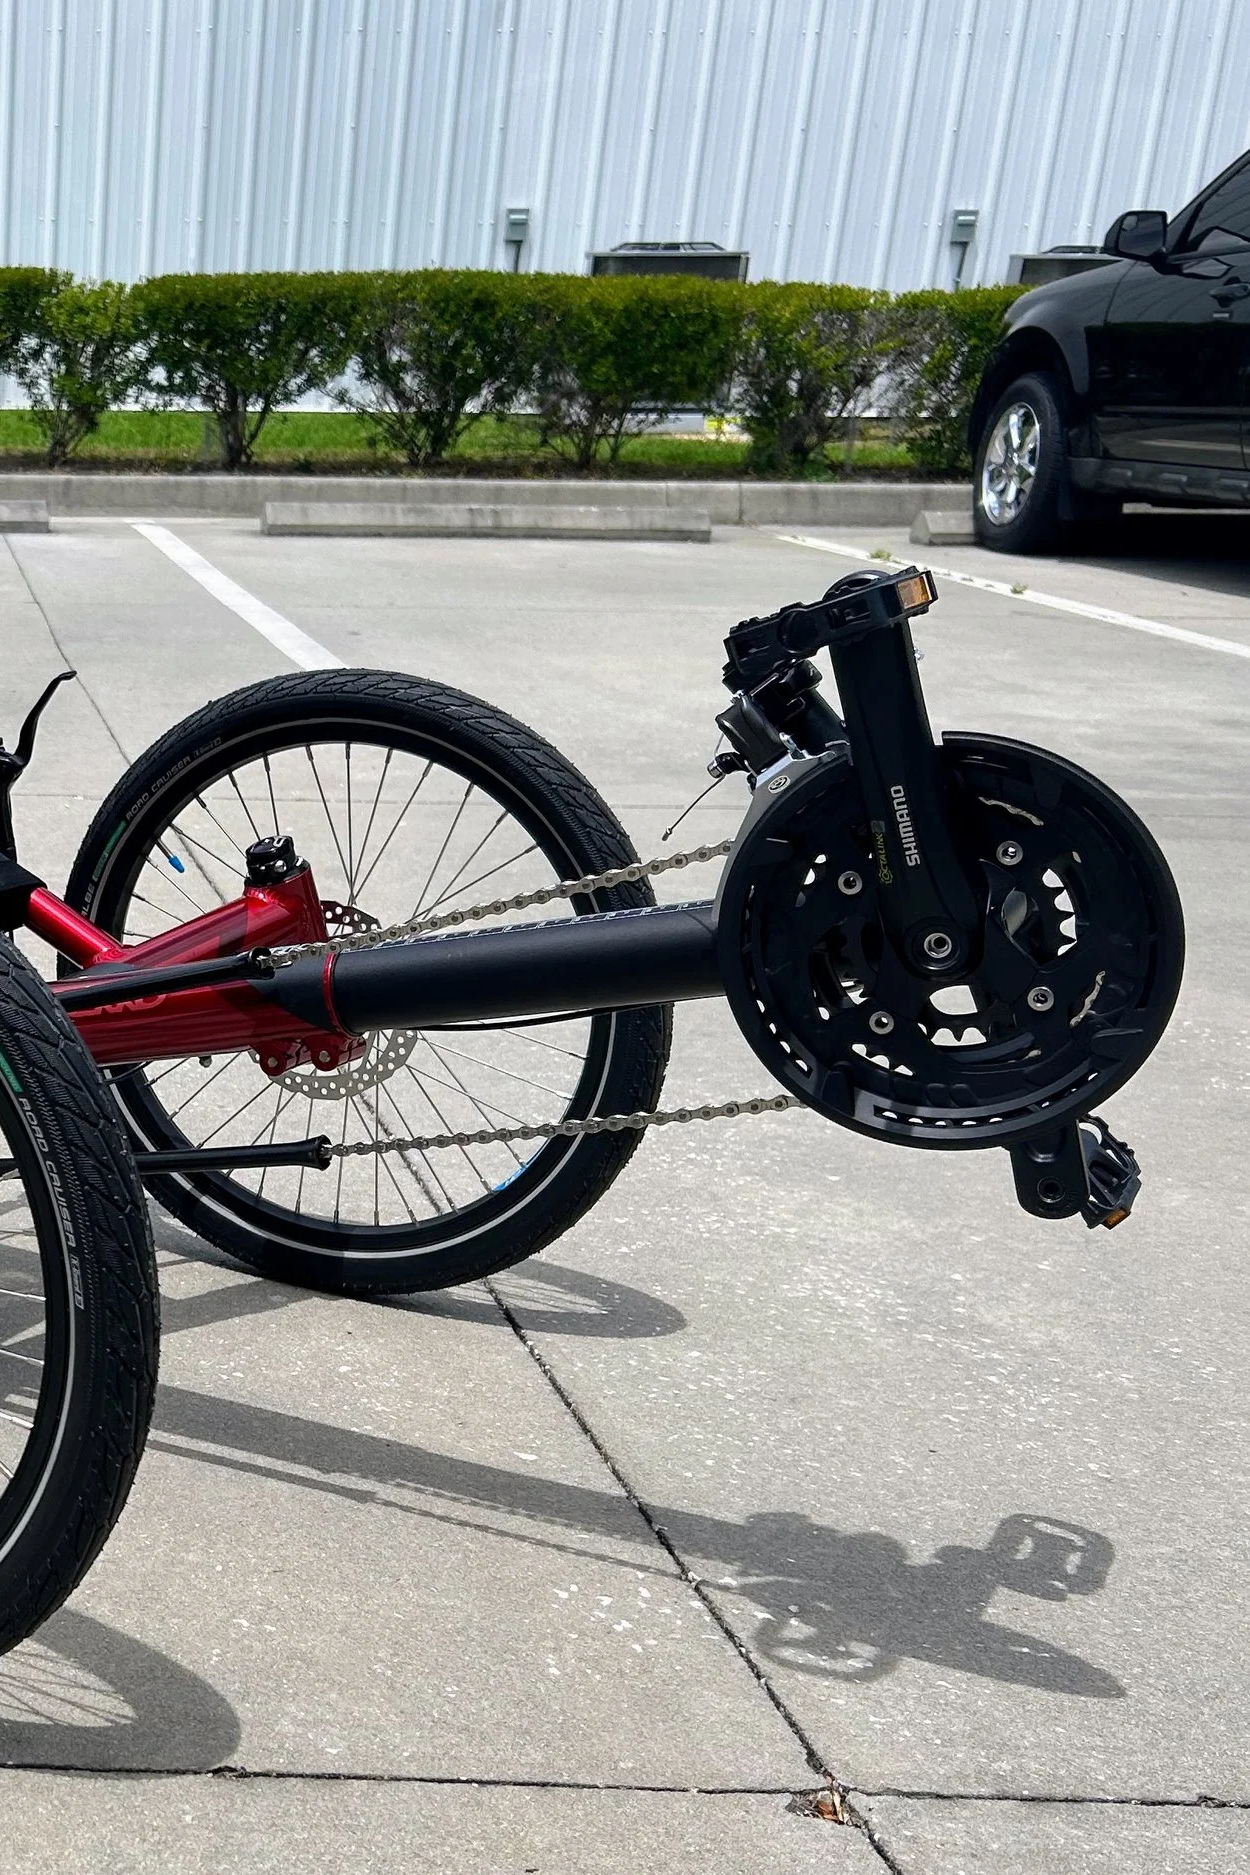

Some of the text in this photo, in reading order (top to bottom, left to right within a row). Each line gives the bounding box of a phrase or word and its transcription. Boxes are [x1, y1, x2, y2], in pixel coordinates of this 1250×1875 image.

[126, 756, 191, 821] ROAD CRUISER
[876, 832, 894, 884] OCTALINK
[890, 785, 921, 867] SHIMANO
[19, 1098, 49, 1153] ROAD
[46, 1160, 77, 1248] CRUISER
